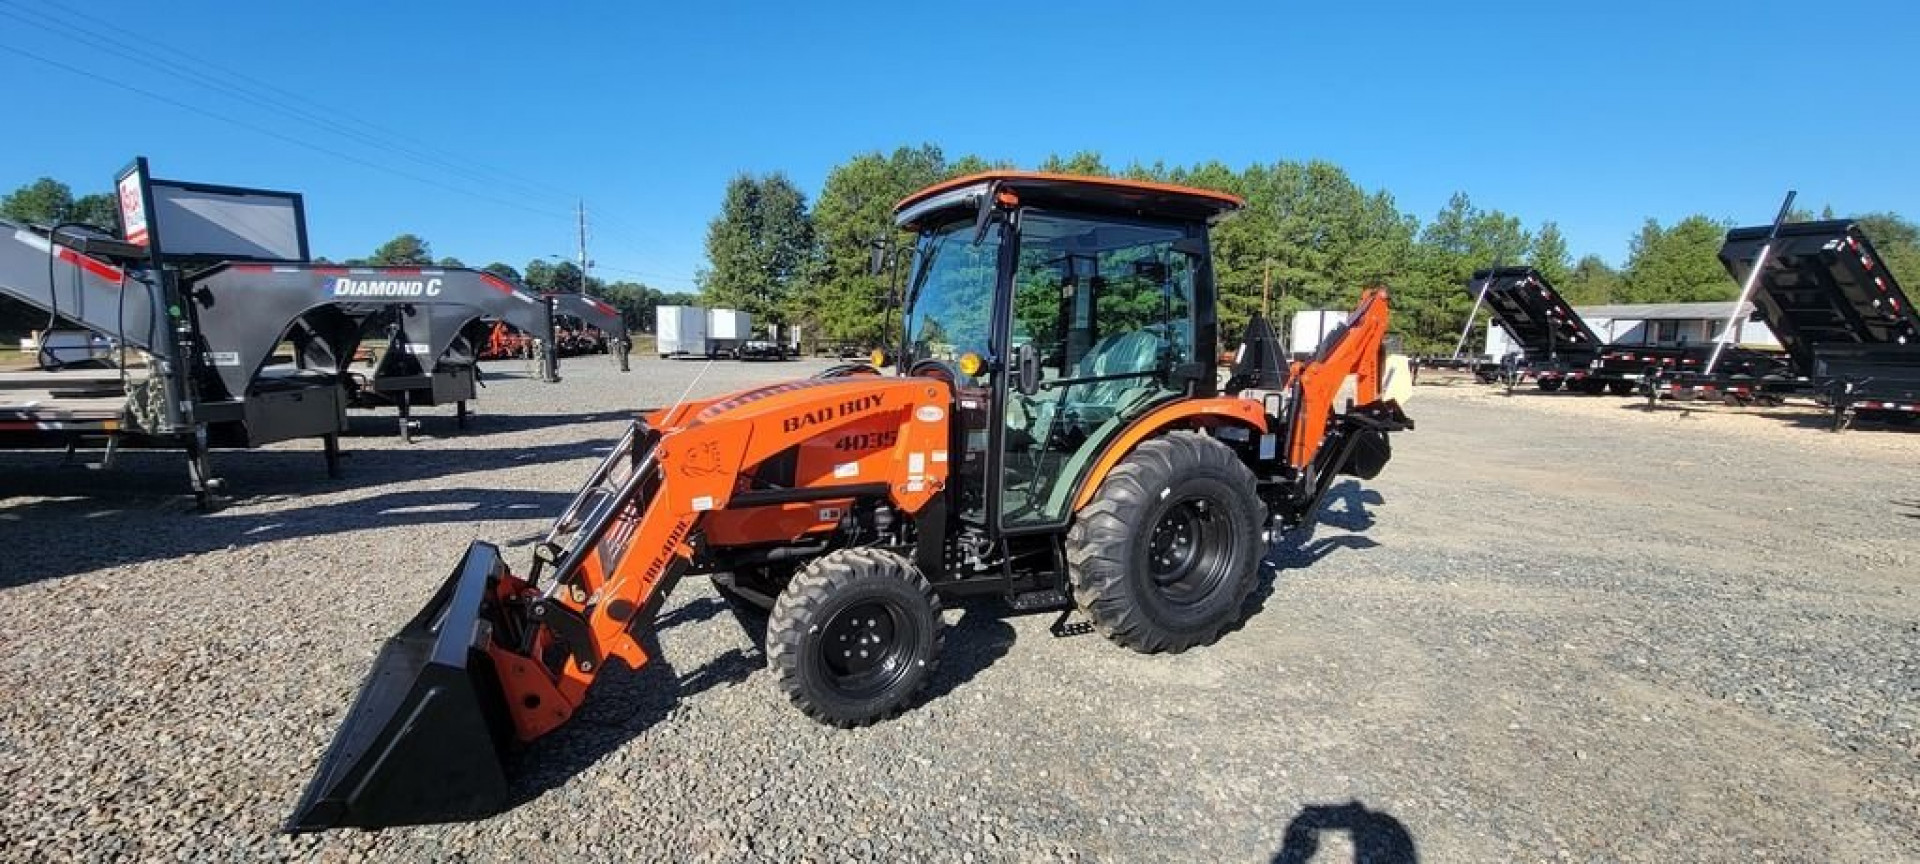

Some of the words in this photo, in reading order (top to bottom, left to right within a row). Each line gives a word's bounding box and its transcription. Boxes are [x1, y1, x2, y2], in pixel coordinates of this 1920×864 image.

[334, 278, 422, 296] DIAMOND
[425, 278, 442, 296] C
[783, 406, 833, 433] BAD
[839, 392, 886, 417] BOY
[835, 431, 899, 450] 4035
